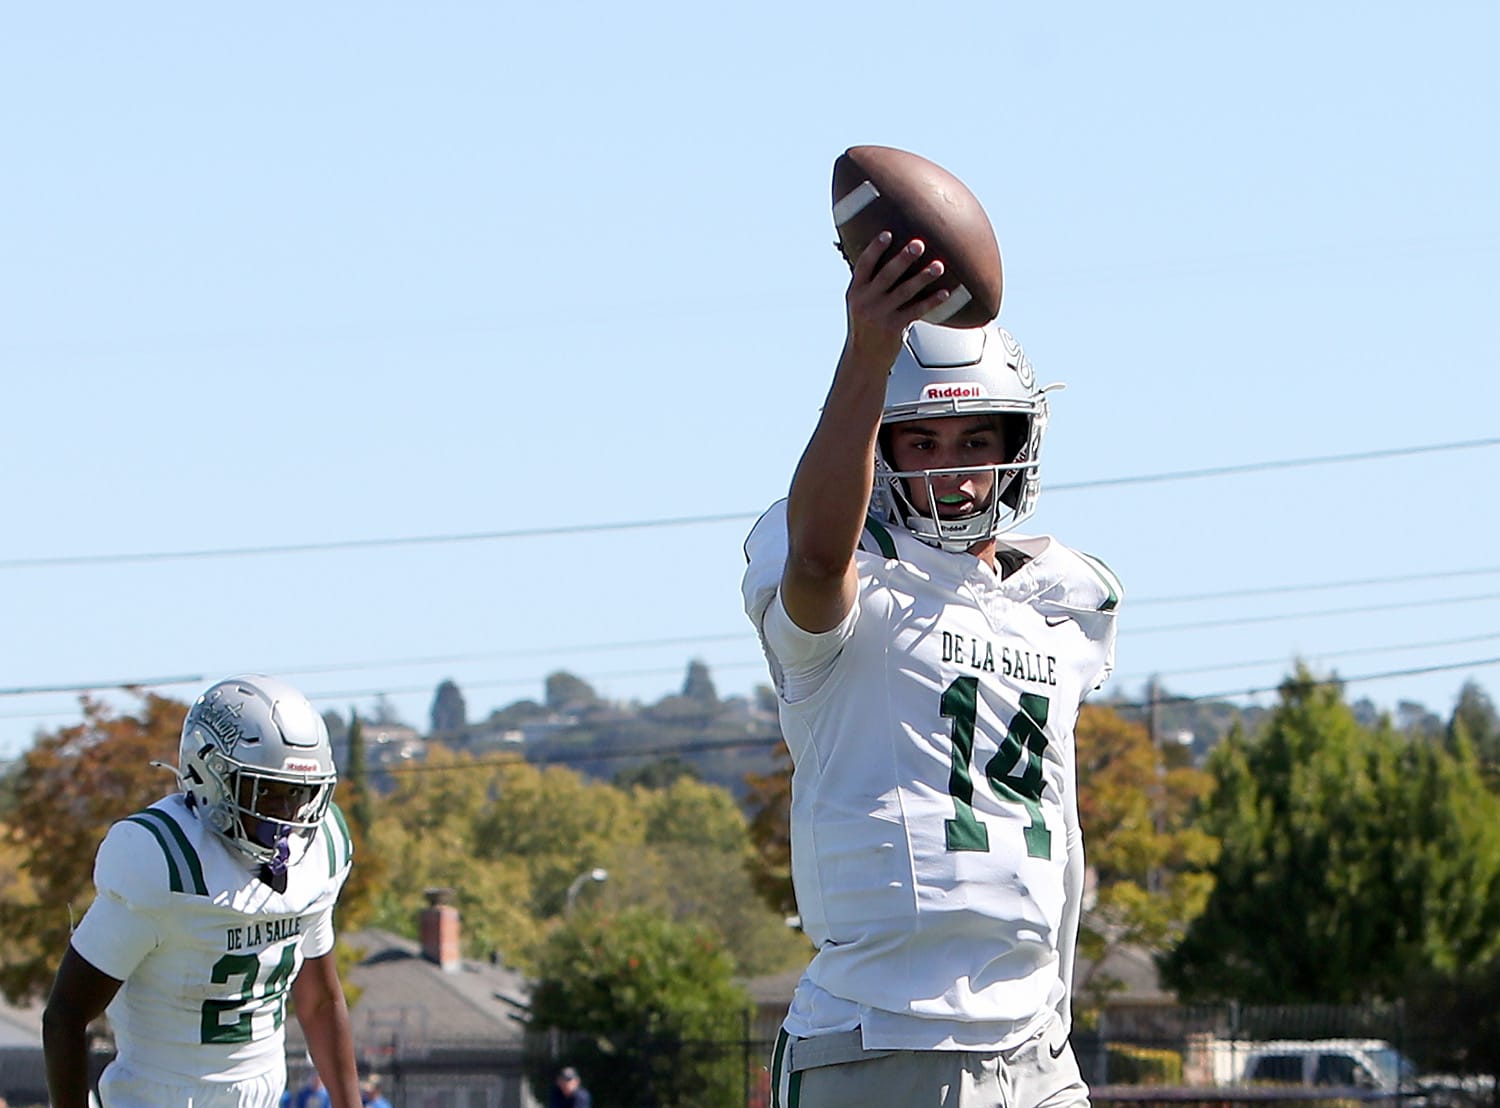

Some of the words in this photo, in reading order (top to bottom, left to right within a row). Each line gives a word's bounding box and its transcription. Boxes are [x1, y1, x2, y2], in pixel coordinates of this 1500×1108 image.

[928, 387, 980, 399] Riddell
[942, 631, 964, 664] DE
[971, 638, 996, 673] LA
[1002, 646, 1057, 686] SALLE
[940, 676, 1052, 861] 14
[227, 928, 242, 950] DE
[247, 924, 262, 947] LA
[266, 917, 302, 942] SALLE
[201, 942, 297, 1044] 24
